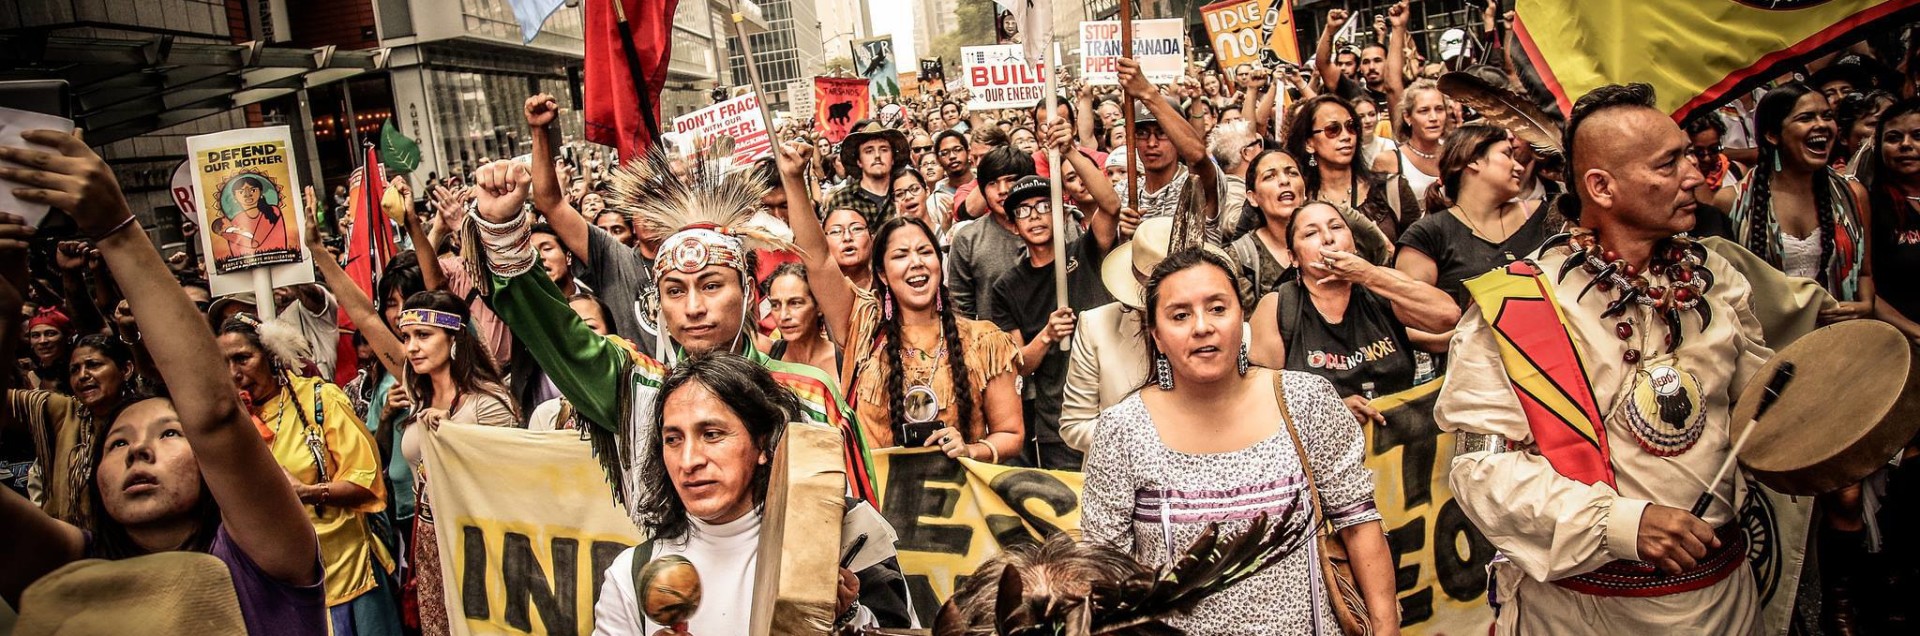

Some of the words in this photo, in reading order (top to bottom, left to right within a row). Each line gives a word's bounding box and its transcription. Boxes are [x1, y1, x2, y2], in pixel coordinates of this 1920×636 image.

[1207, 2, 1261, 33] IDLE
[1085, 24, 1118, 40] STOP
[1085, 38, 1180, 56] TRANCANADA
[1215, 27, 1258, 61] NO
[970, 63, 1046, 87] BUILD
[985, 88, 1005, 102] OUR
[1007, 85, 1044, 101] ENERGY
[677, 110, 715, 135] DON'T
[702, 122, 723, 133] WITH
[724, 115, 742, 126] OUR
[701, 119, 757, 149] ATER!
[204, 161, 230, 173] OUR
[235, 154, 283, 169] MOTHER
[207, 144, 277, 164] DEFEND
[1346, 350, 1363, 370] NO
